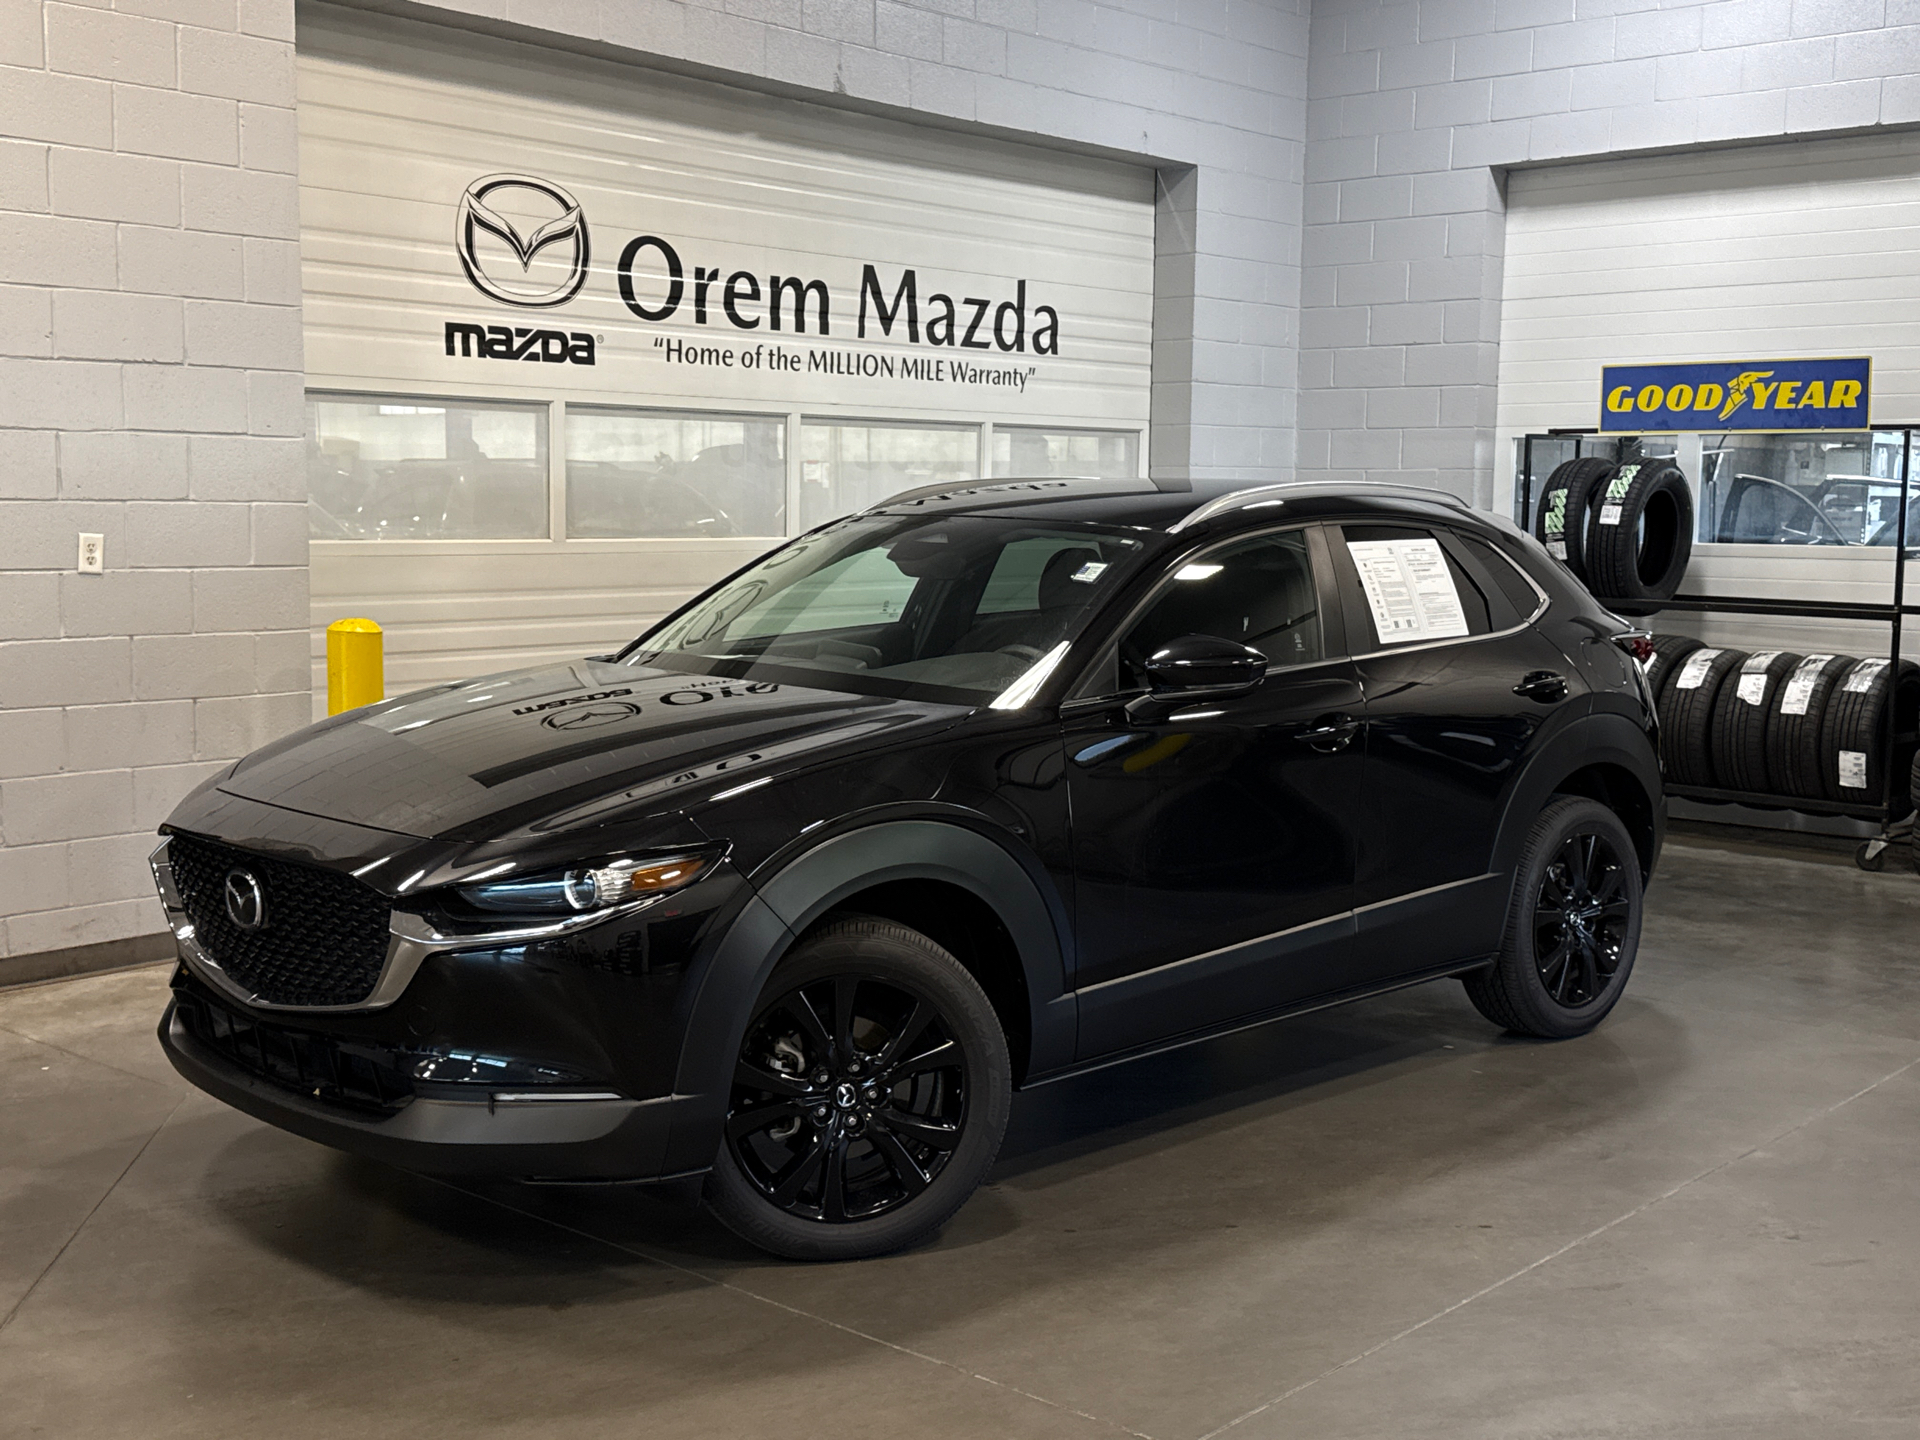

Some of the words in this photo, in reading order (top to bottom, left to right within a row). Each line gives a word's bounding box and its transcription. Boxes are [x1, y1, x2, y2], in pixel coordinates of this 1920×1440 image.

[617, 235, 830, 336] Orem
[857, 264, 1059, 356] Mazda
[741, 344, 764, 369] of
[768, 346, 801, 372] the
[807, 350, 895, 378] MILLION
[900, 357, 944, 382] MILE
